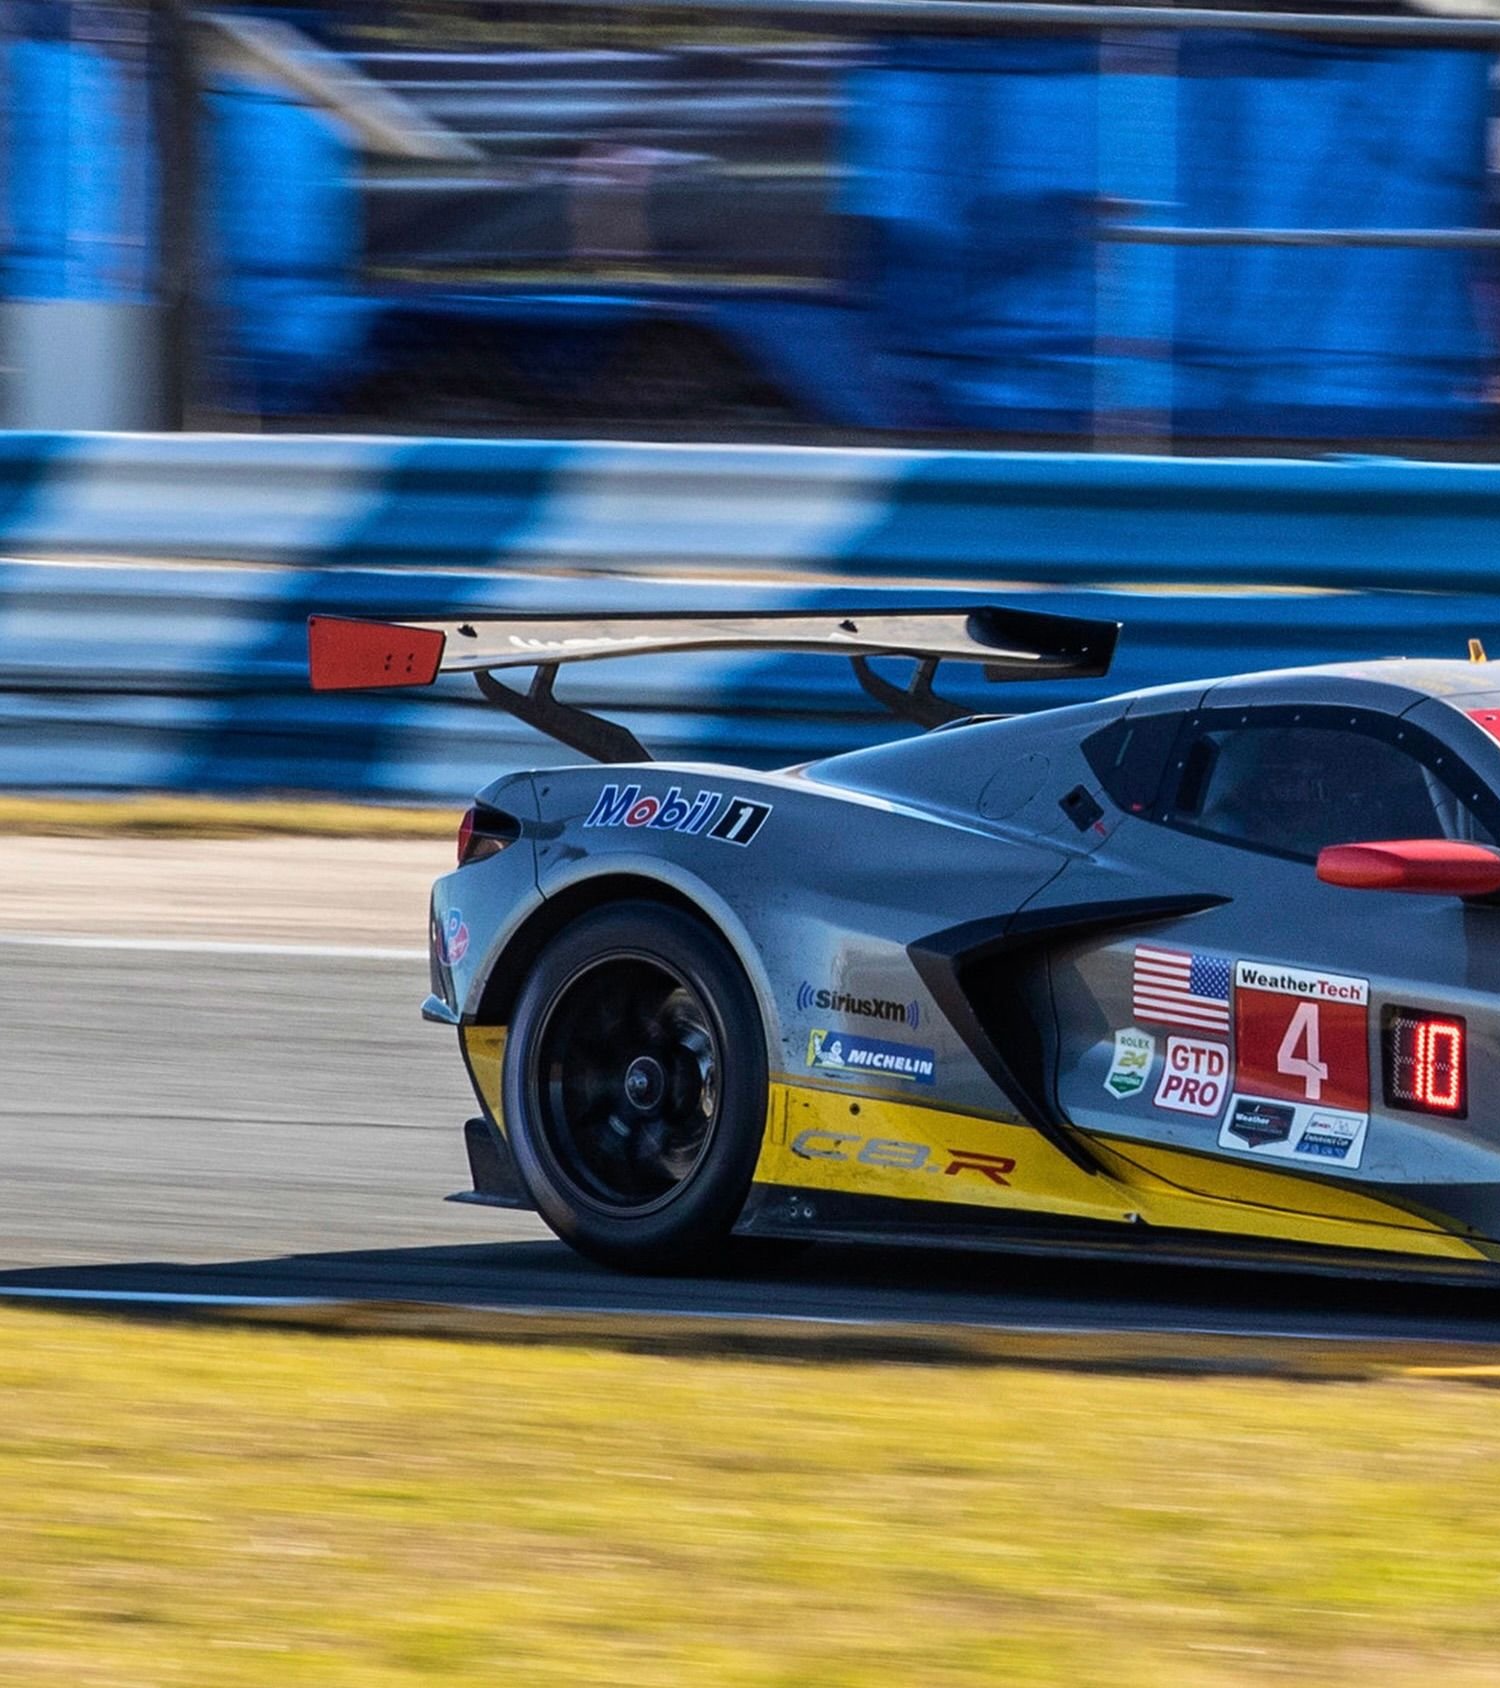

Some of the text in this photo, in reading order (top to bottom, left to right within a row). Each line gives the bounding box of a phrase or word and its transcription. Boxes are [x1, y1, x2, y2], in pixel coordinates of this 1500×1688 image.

[583, 784, 723, 835] Mobil
[1241, 967, 1361, 1000] WeatherTech
[1120, 1036, 1150, 1049] ROLEX
[1277, 1001, 1328, 1100] 4
[847, 1049, 933, 1076] MICHELIN
[1118, 1050, 1149, 1069] 24
[1171, 1044, 1225, 1078] GTD
[1415, 1021, 1461, 1109] 10
[1161, 1074, 1219, 1107] PRO
